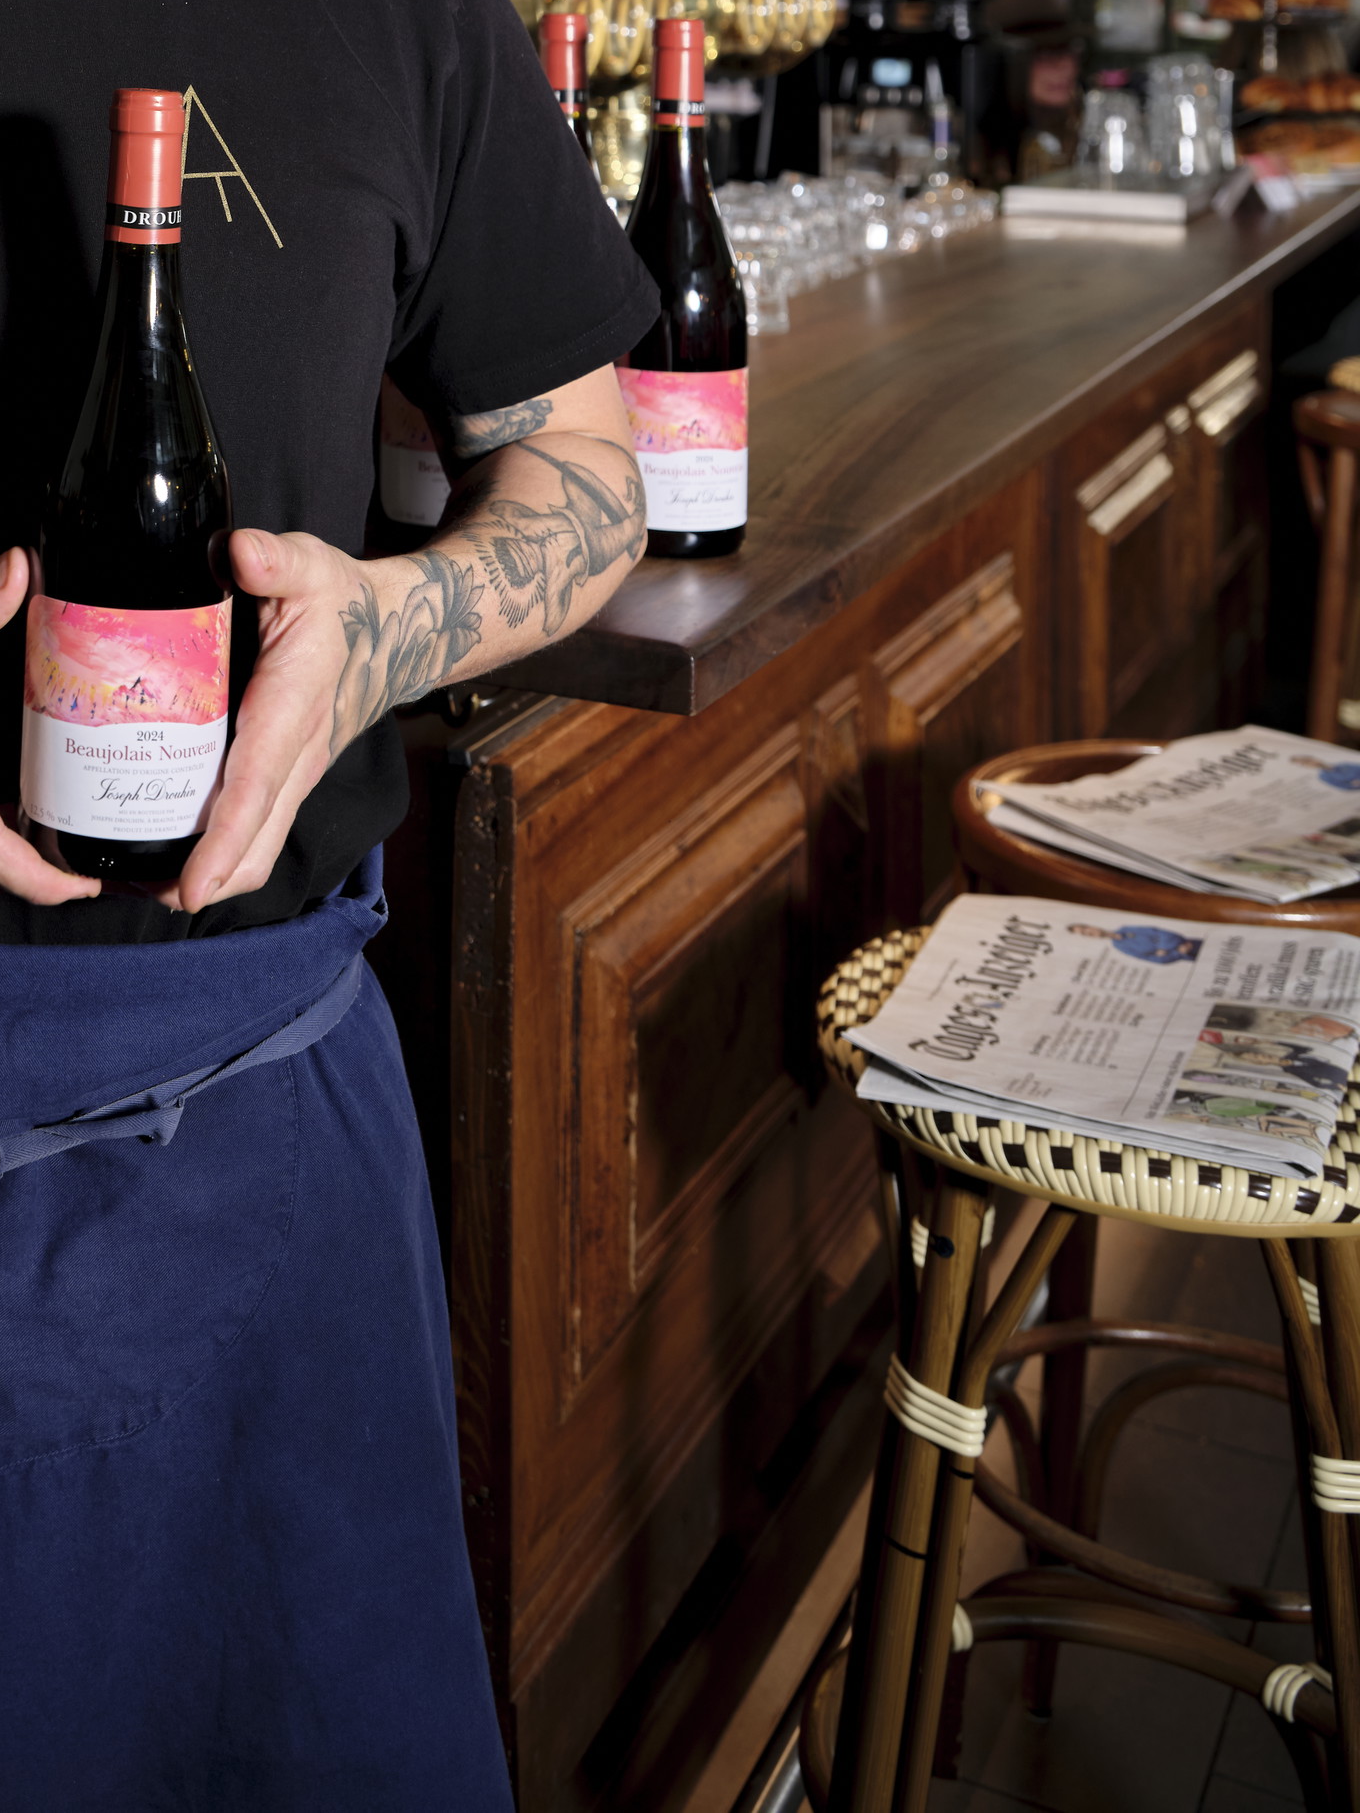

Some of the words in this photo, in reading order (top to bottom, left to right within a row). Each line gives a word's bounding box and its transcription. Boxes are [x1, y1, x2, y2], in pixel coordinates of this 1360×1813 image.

[136, 730, 164, 741] 2024
[65, 738, 152, 764] Beaujolais
[159, 739, 217, 761] Nouveau
[83, 764, 130, 775] APPELLATION
[91, 778, 144, 807] Joseph
[144, 777, 196, 801] Drouhin
[58, 815, 74, 827] vol.
